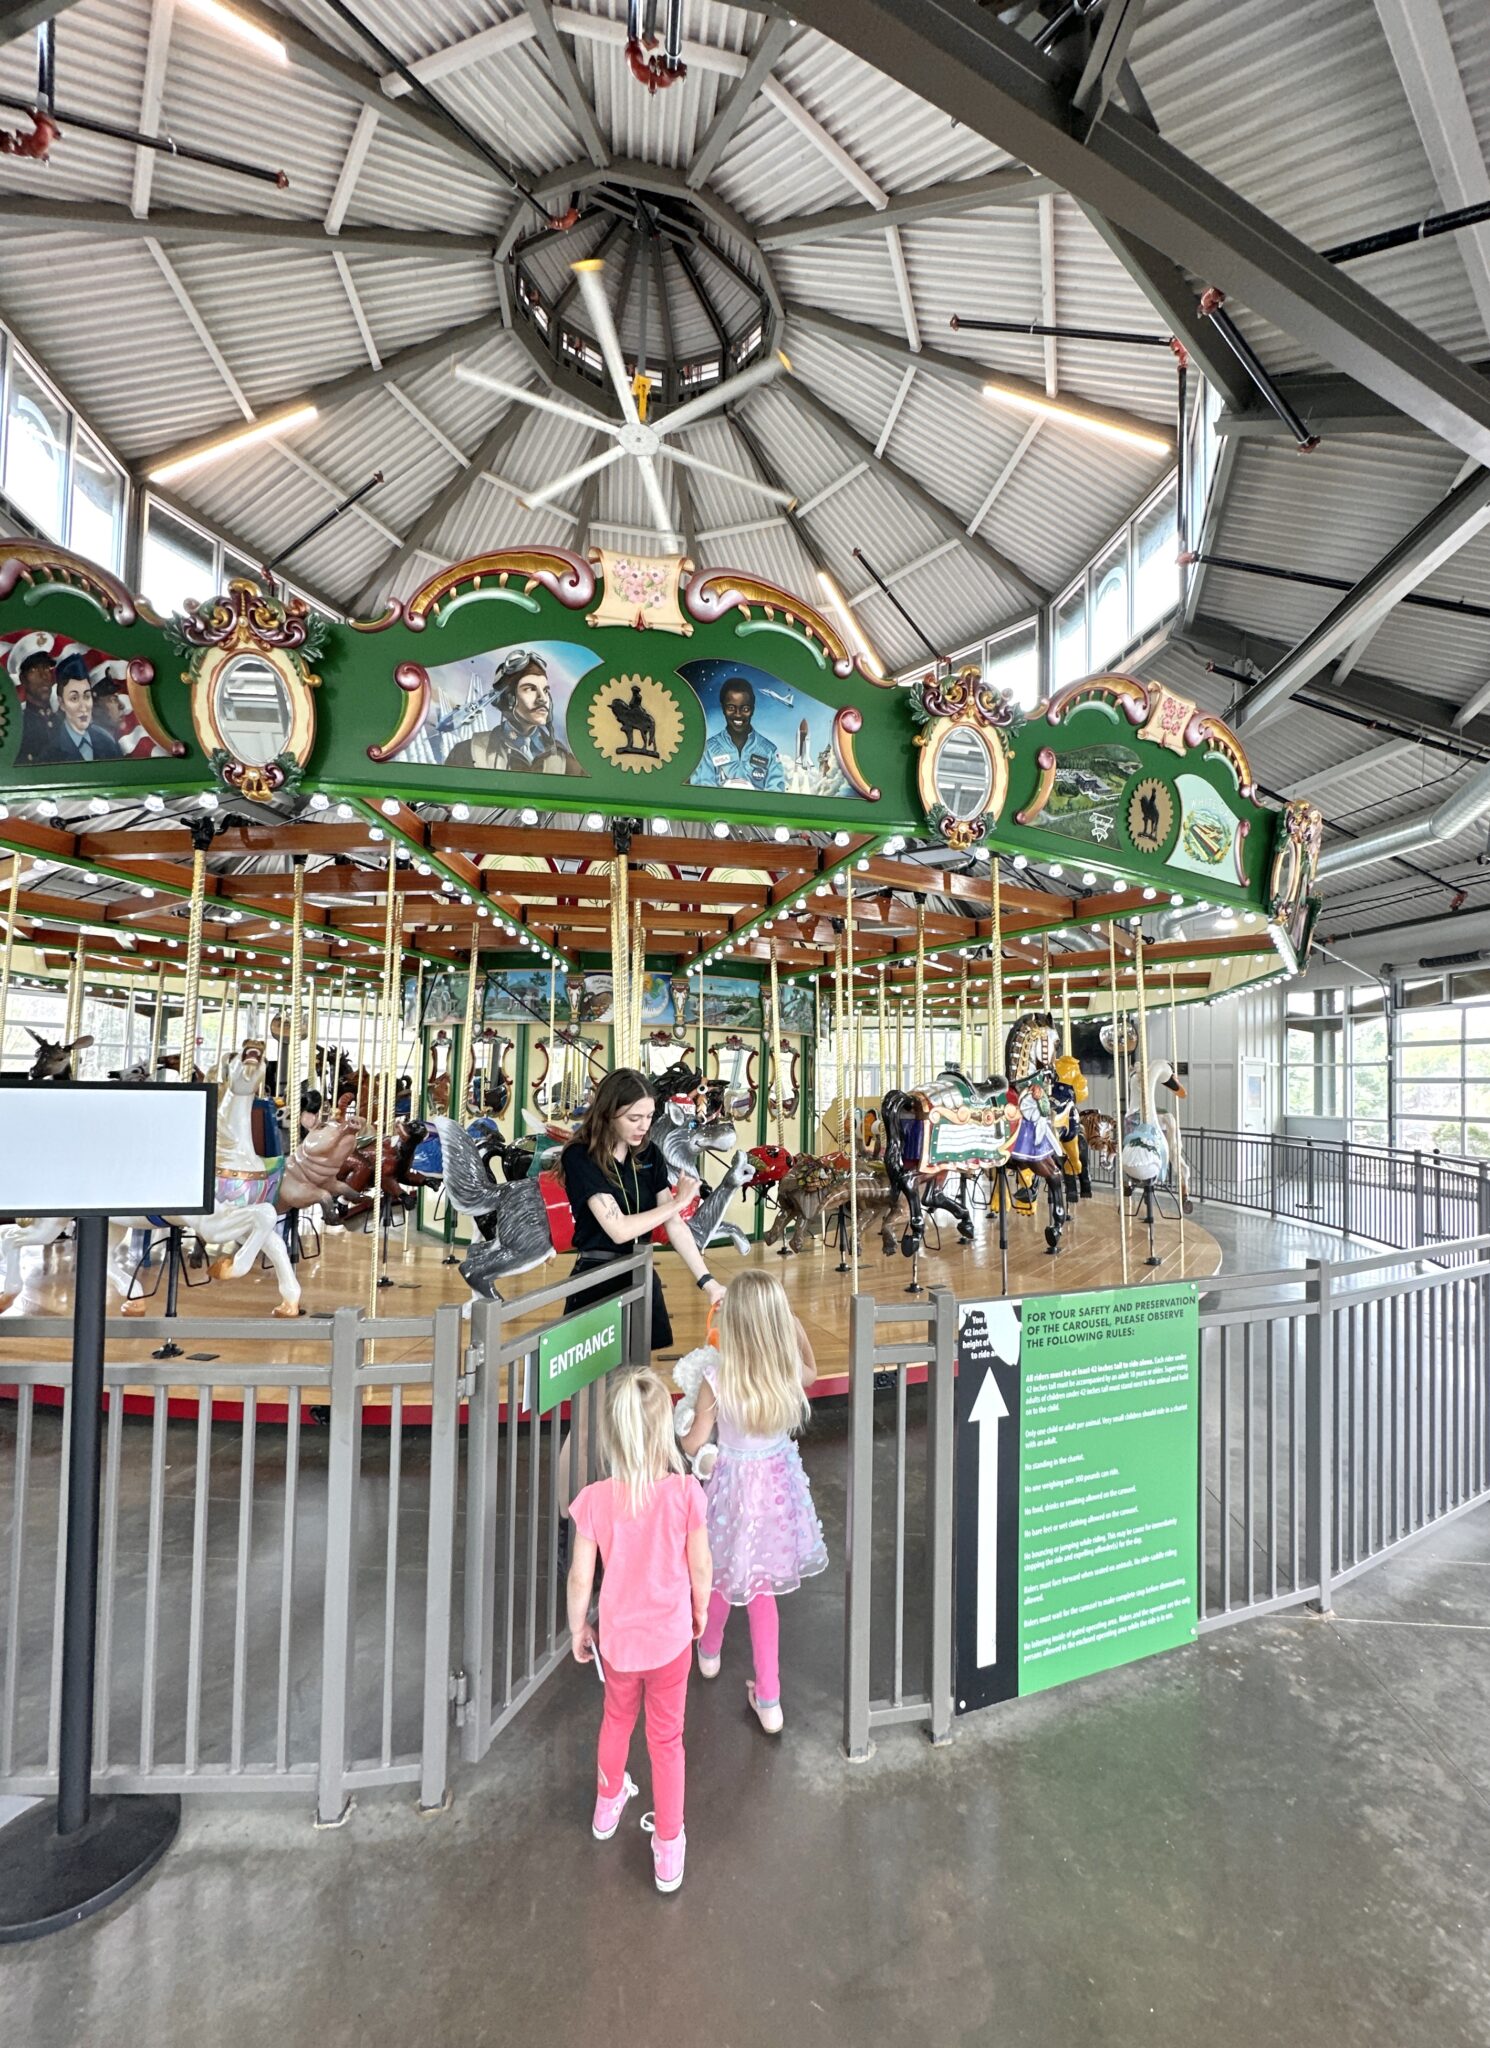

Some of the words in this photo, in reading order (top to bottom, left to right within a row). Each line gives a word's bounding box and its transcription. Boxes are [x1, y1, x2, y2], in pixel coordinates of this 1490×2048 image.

[972, 1316, 983, 1324] You
[1027, 1312, 1046, 1322] FOR
[1049, 1309, 1076, 1320] YOUR
[1079, 1305, 1110, 1317] SAFETY
[1113, 1303, 1132, 1313] AND
[1135, 1296, 1196, 1310] PRESERVATION
[1027, 1325, 1040, 1336] OF
[1043, 1324, 1059, 1333] THE
[1063, 1318, 1111, 1331] CAROUSEL,
[1115, 1314, 1144, 1325] PLEASE
[1147, 1309, 1183, 1321] OBSERVE
[962, 1339, 982, 1349] height
[1026, 1338, 1044, 1349] THE
[1047, 1331, 1103, 1346] FOLLOWING
[1106, 1327, 1134, 1339] RULES:
[550, 1324, 615, 1379] ENTRANCE
